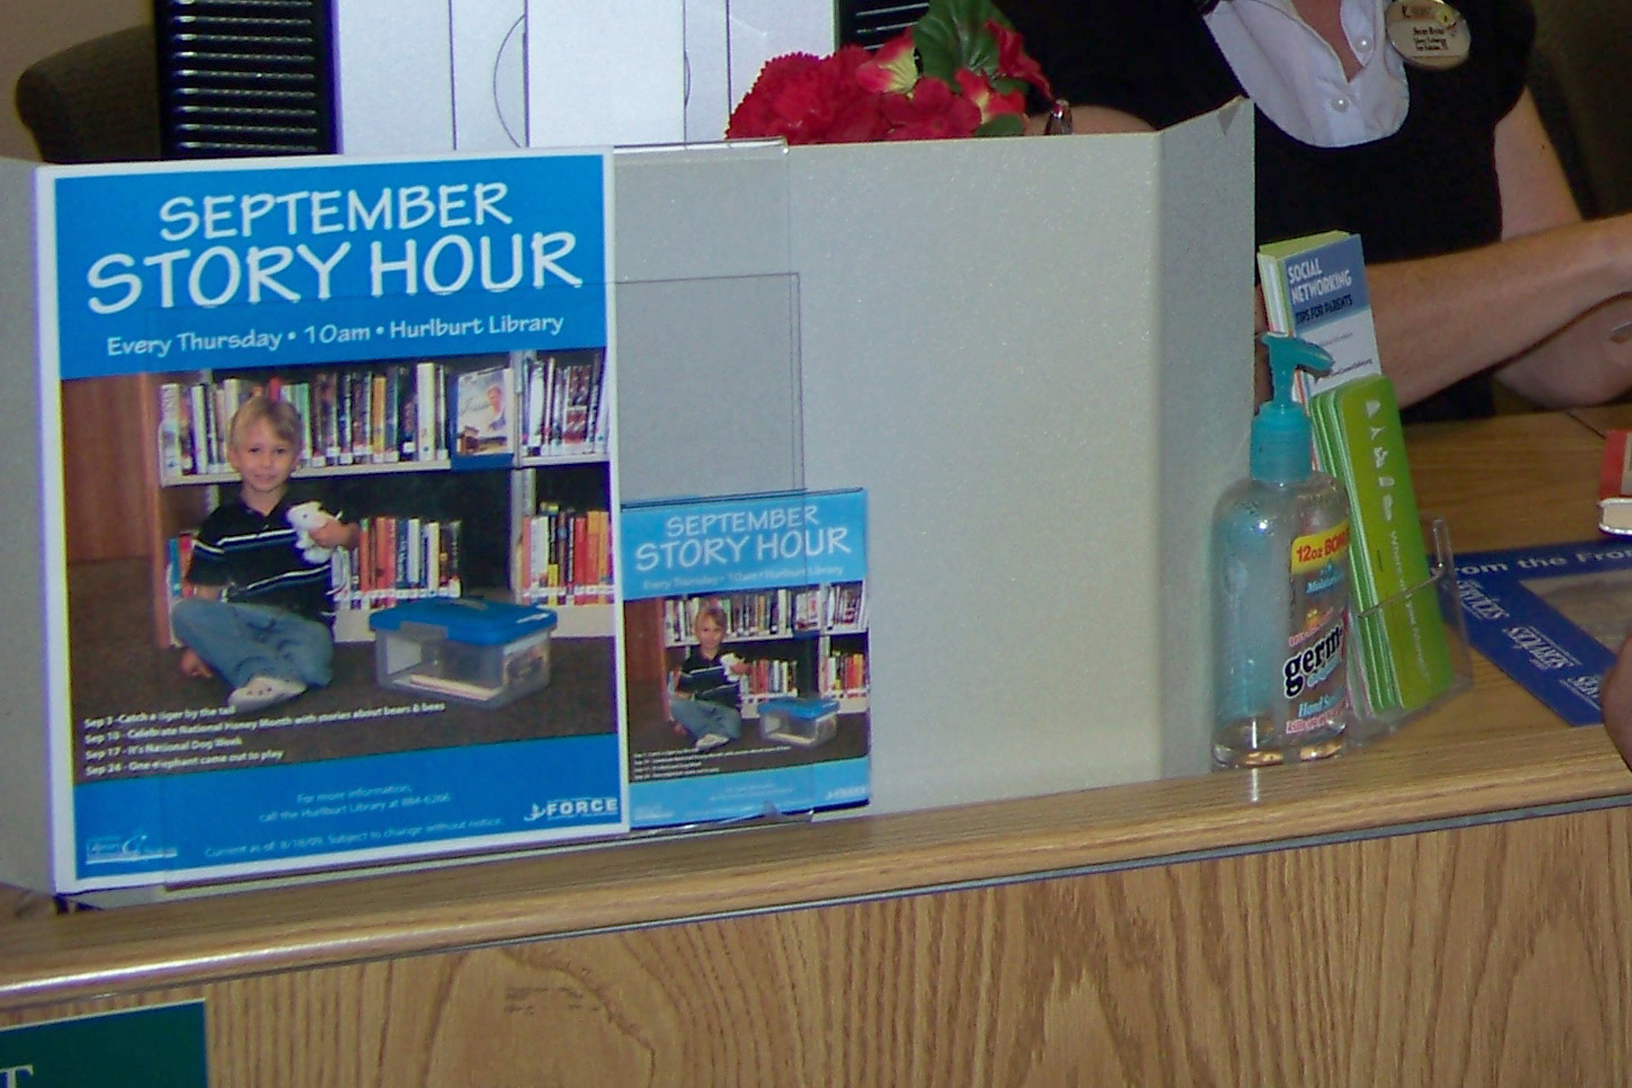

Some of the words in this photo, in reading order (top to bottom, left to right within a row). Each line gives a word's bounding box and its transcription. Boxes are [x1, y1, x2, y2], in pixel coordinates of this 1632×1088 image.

[159, 181, 513, 242] SEPTEMBER
[87, 242, 353, 314] STORY
[369, 231, 583, 298] HOUR
[1287, 257, 1322, 284] SOCIAL
[1291, 269, 1352, 305] NETWORKING
[107, 335, 171, 359] Every
[176, 327, 282, 352] Thursday
[303, 324, 370, 345] 10am
[389, 317, 483, 339] Hurlburt
[488, 312, 564, 336] Library
[667, 505, 819, 538] SEPTEMBER
[635, 535, 749, 572] STORY
[757, 527, 851, 561] HOUR
[1517, 554, 1567, 569] the
[84, 715, 105, 727] Sep
[84, 732, 105, 744] Sep
[85, 747, 106, 760] Sep
[85, 764, 105, 776] Sep
[546, 798, 618, 817] FORCE
